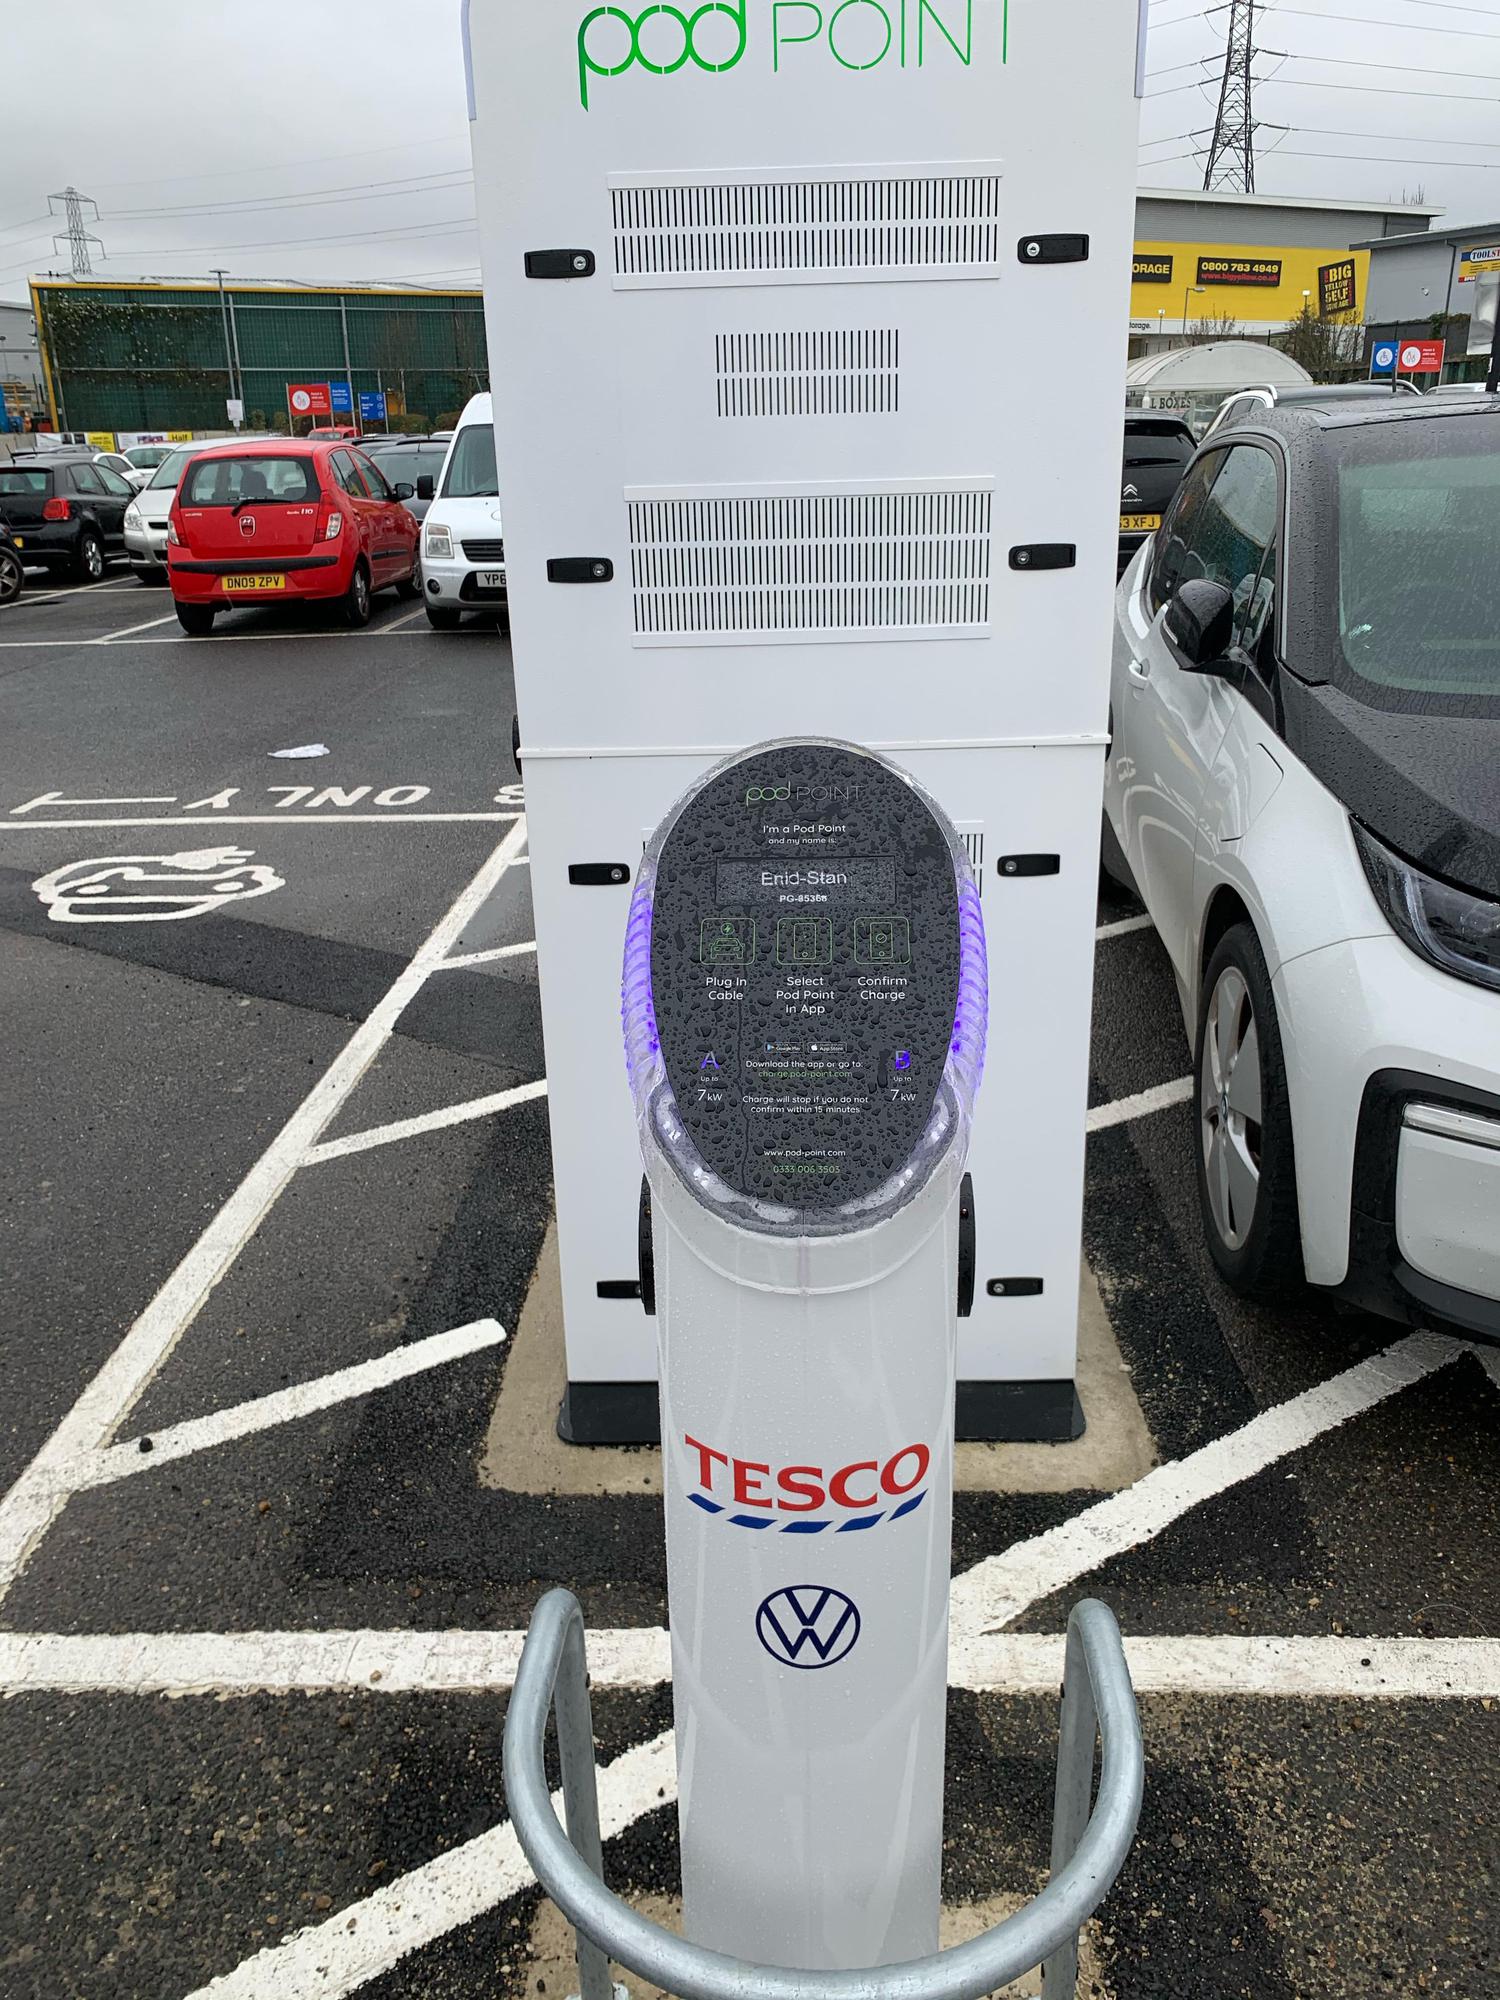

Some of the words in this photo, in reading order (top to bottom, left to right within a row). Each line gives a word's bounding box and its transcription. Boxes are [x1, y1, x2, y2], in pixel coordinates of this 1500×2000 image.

[577, 0, 747, 112] pod
[1201, 262, 1229, 271] 0800
[1230, 263, 1251, 272] 783
[1252, 264, 1279, 273] 4949
[1329, 264, 1352, 283] BIG
[1325, 280, 1348, 292] YELLOW
[1325, 287, 1349, 304] SELF
[1133, 517, 1155, 528] XFJ
[227, 577, 256, 589] DN09
[259, 576, 281, 588] ZPV
[182, 785, 431, 809] ONLY
[746, 780, 791, 807] pod
[796, 785, 865, 801] POINT
[763, 825, 780, 833] I'm
[782, 826, 790, 834] a
[793, 824, 815, 833] Pod
[818, 824, 846, 833] Point
[768, 837, 785, 845] and
[786, 838, 800, 846] my
[761, 870, 847, 886] Enid-Stan
[706, 976, 732, 989] Plug
[736, 977, 747, 986] In
[786, 976, 824, 986] Select
[857, 976, 908, 986] Confirm
[708, 990, 744, 1000] Cable
[776, 990, 800, 1000] Pod
[803, 990, 835, 1000] Point
[860, 990, 906, 1002] Charge
[800, 1004, 826, 1015] App
[701, 1051, 720, 1069] A
[745, 1060, 789, 1068] Download
[791, 1060, 806, 1068] the
[807, 1062, 825, 1070] app
[838, 1062, 850, 1070] go
[895, 1050, 911, 1069] B
[758, 1070, 853, 1079] charge.pod-point.com
[742, 1095, 774, 1104] Charge
[776, 1095, 790, 1103] will
[792, 1096, 811, 1104] stop
[813, 1095, 819, 1103] if
[821, 1096, 838, 1104] you
[840, 1095, 852, 1103] do
[763, 1149, 846, 1157] www.pod-point.com
[773, 1165, 795, 1174] 0333
[797, 1165, 816, 1174] 006
[817, 1165, 841, 1174] 3503
[684, 1433, 930, 1512] TESCO
